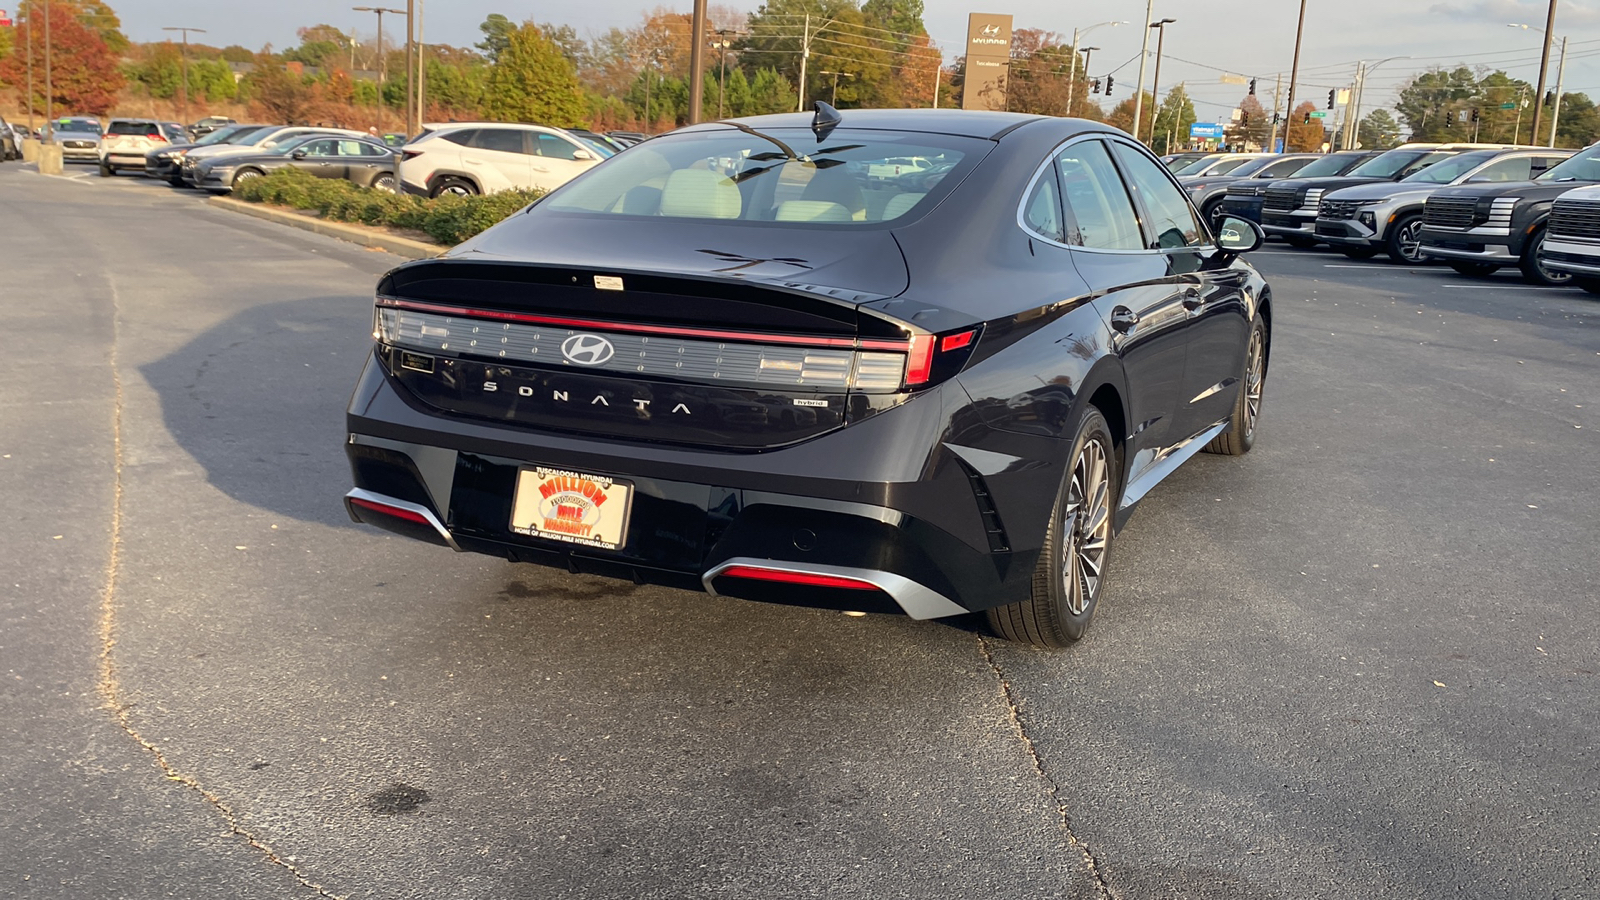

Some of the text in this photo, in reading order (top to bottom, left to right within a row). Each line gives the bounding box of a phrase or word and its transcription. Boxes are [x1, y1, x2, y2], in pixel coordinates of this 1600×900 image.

[483, 381, 691, 415] SONATA
[536, 467, 613, 484] TUSCALOOSA HYUNDAI
[538, 476, 608, 507] MILLION
[556, 504, 583, 522] MILE
[514, 527, 530, 535] HOME
[539, 531, 562, 540] MILLION
[562, 535, 574, 543] MILE
[543, 517, 593, 537] WARRANTY
